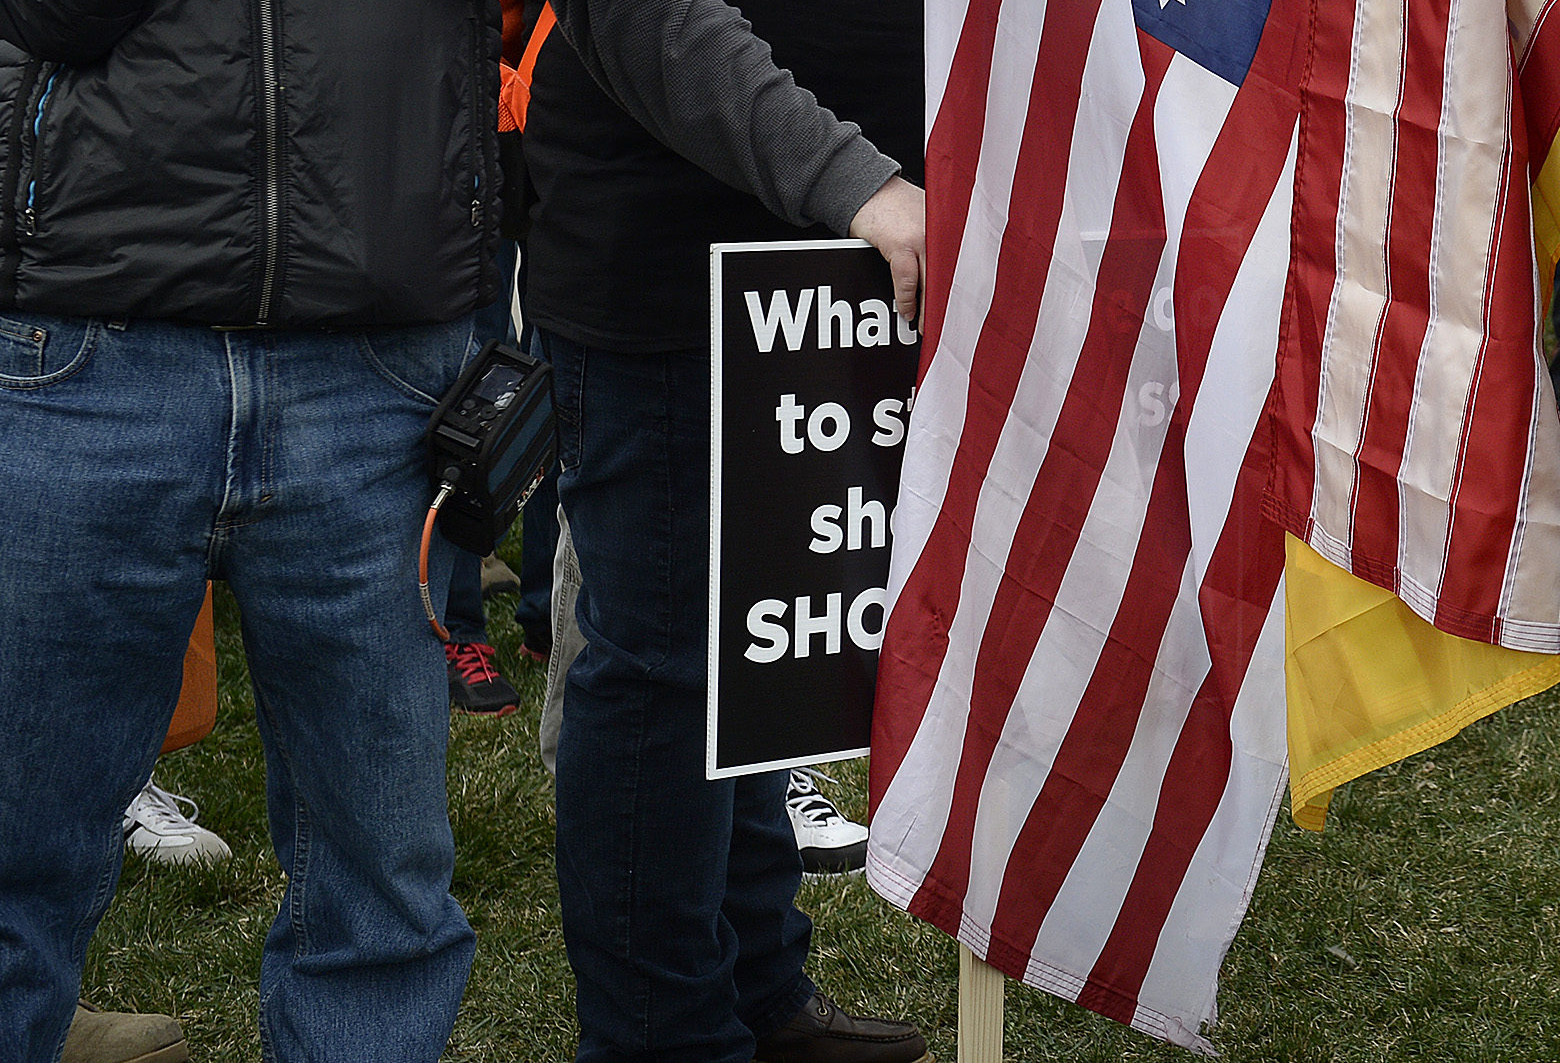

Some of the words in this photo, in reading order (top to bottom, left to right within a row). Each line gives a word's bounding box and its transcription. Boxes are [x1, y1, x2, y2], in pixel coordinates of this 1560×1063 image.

[744, 285, 918, 354] What
[775, 393, 851, 455] to
[809, 486, 899, 555] sh
[744, 587, 888, 665] SHO
